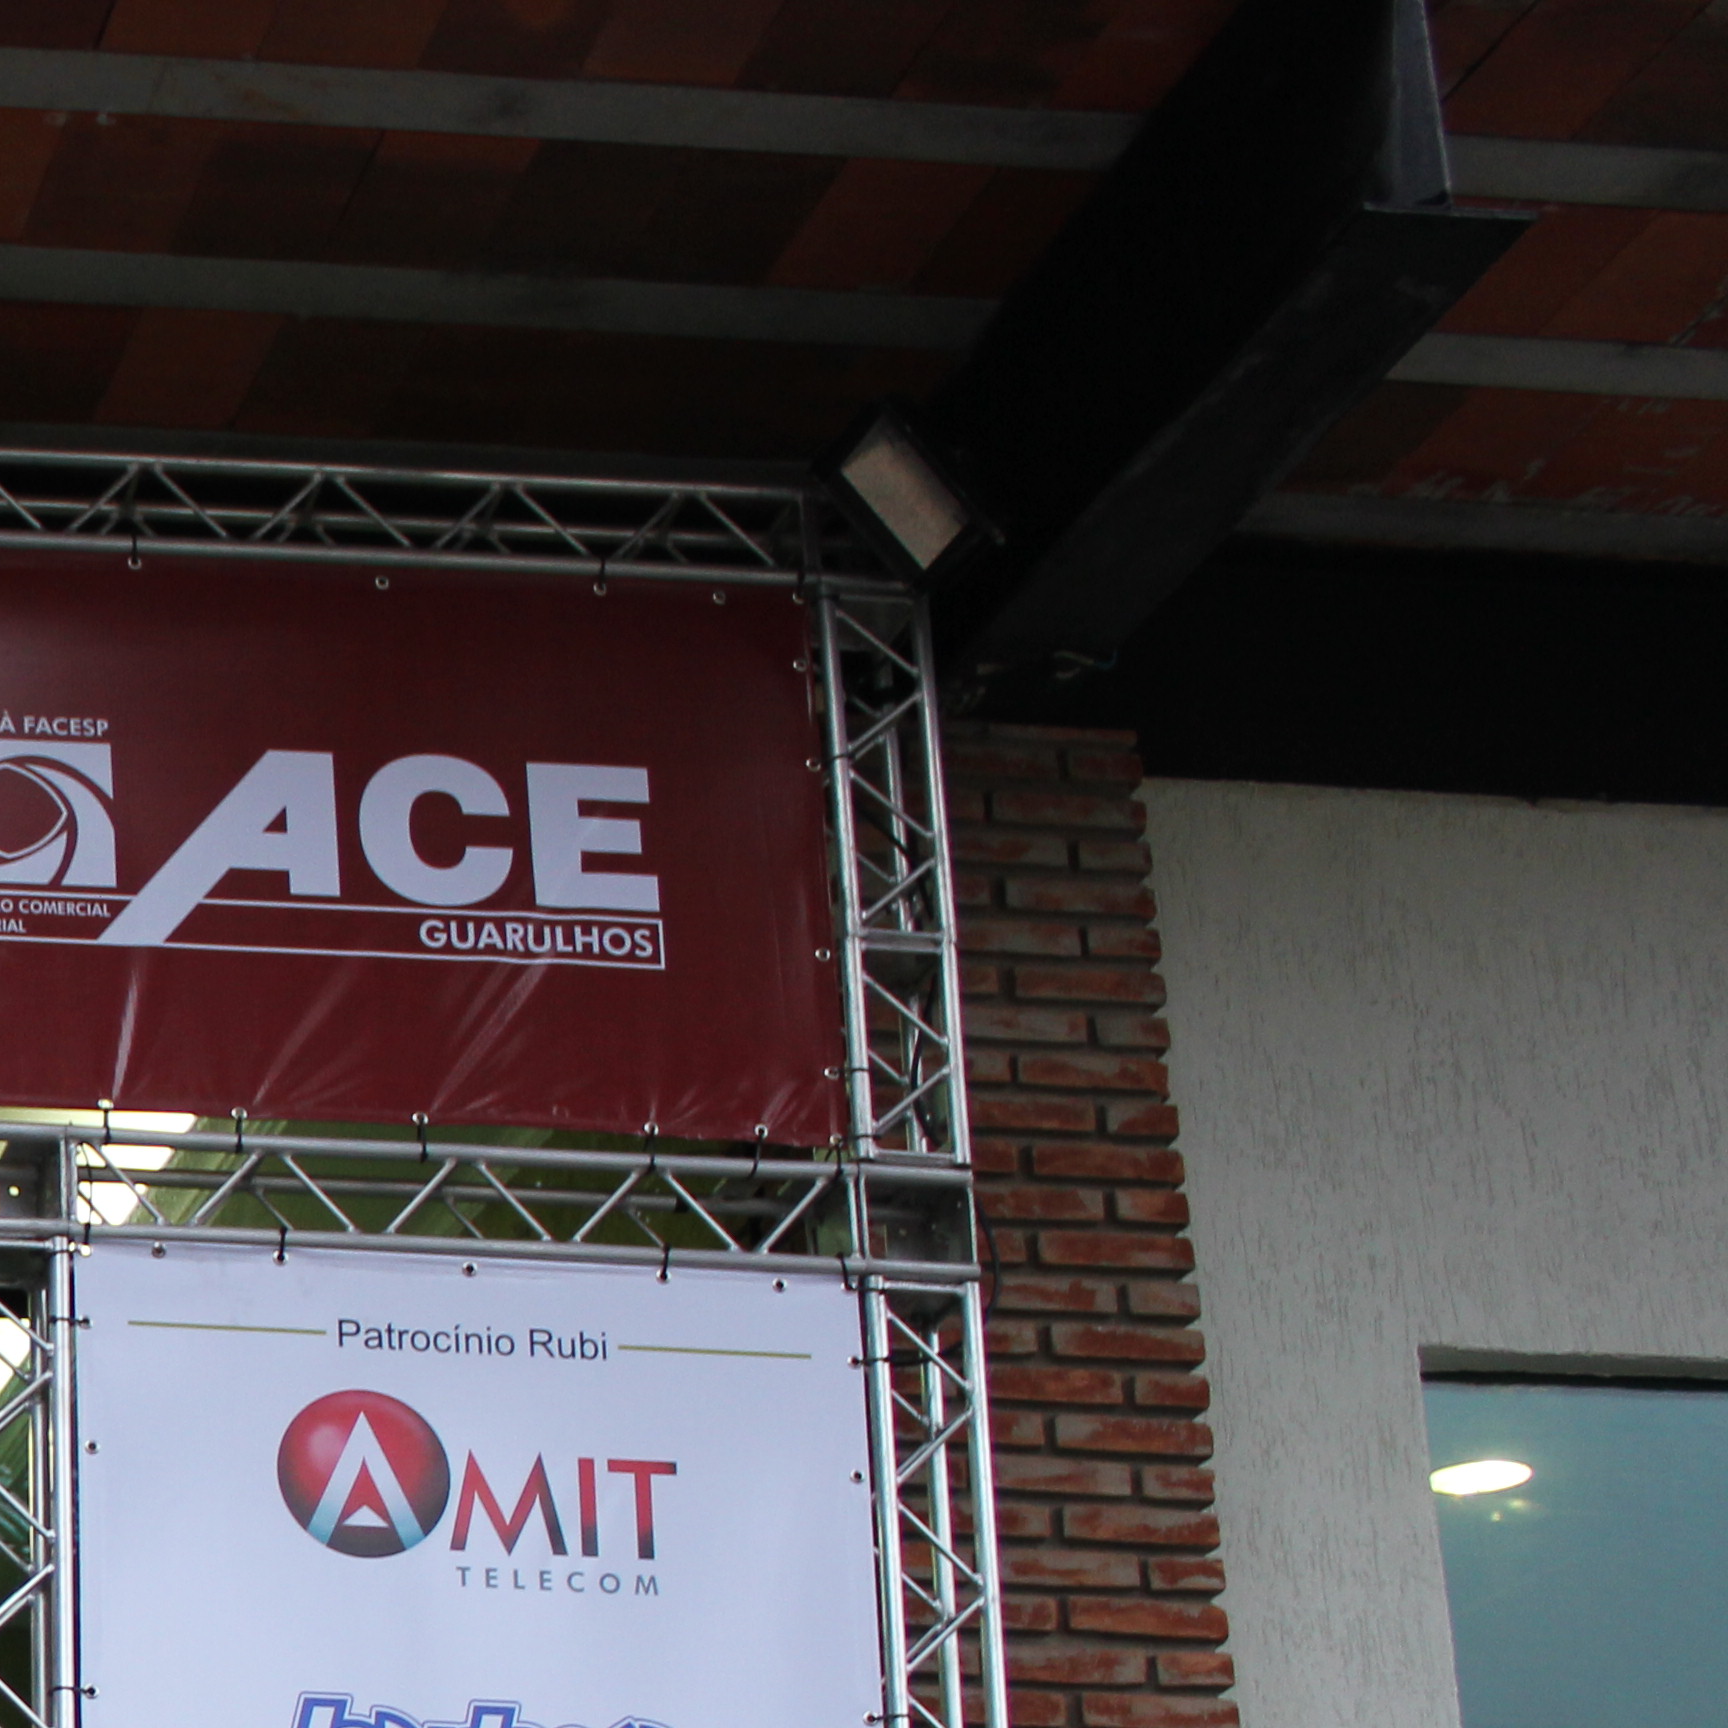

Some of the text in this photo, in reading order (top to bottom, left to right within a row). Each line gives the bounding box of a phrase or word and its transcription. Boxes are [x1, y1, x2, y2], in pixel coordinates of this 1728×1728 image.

[23, 716, 109, 737] FACESP
[97, 749, 660, 945] ACE
[18, 899, 111, 918] COMERCIAL
[418, 917, 655, 959] GUARULHOS
[337, 1319, 609, 1361] Patrocínio Rubi
[305, 1410, 678, 1561] AMIT
[455, 1566, 660, 1596] TELECOM
